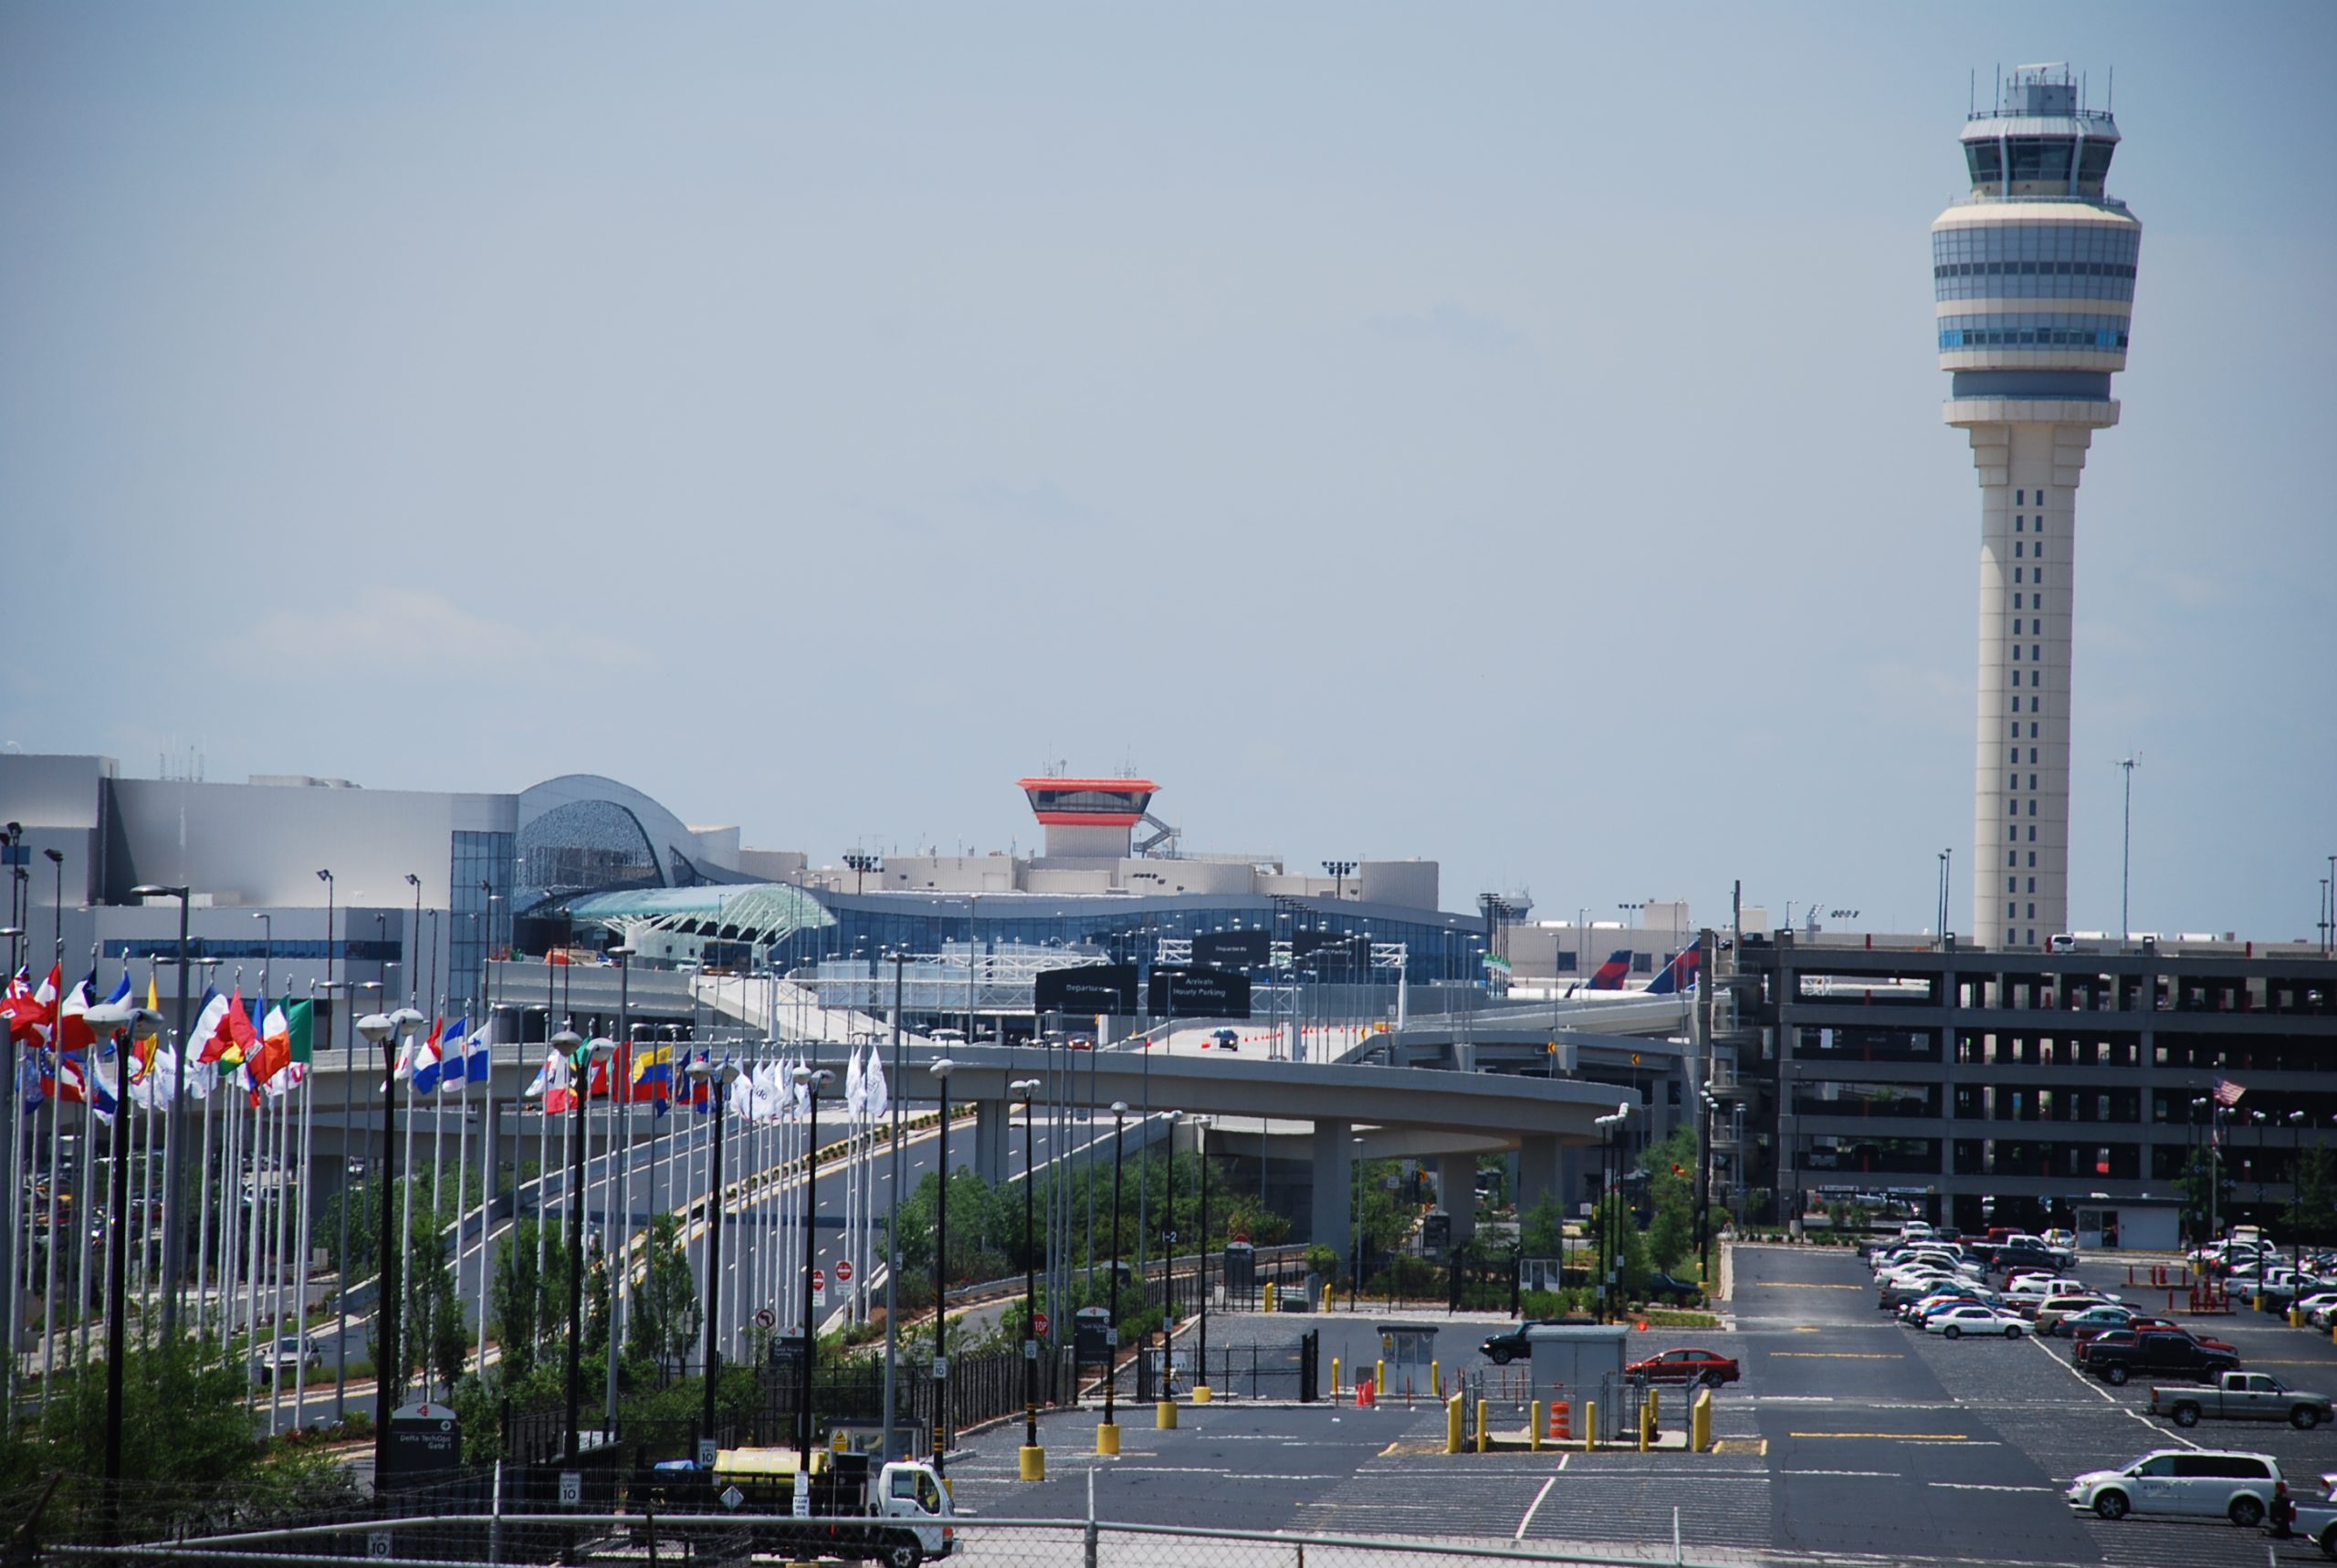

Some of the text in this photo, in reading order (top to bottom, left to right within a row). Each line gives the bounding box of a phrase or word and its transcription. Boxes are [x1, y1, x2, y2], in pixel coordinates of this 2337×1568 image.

[1173, 988, 1226, 998] Hourly Parking
[1034, 1322, 1047, 1332] TOP
[936, 1367, 944, 1375] 10
[422, 1435, 451, 1444] TechOps
[427, 1442, 445, 1450] Gate
[702, 1453, 713, 1462] 10
[563, 1490, 576, 1500] 10
[372, 1542, 386, 1554] 10
